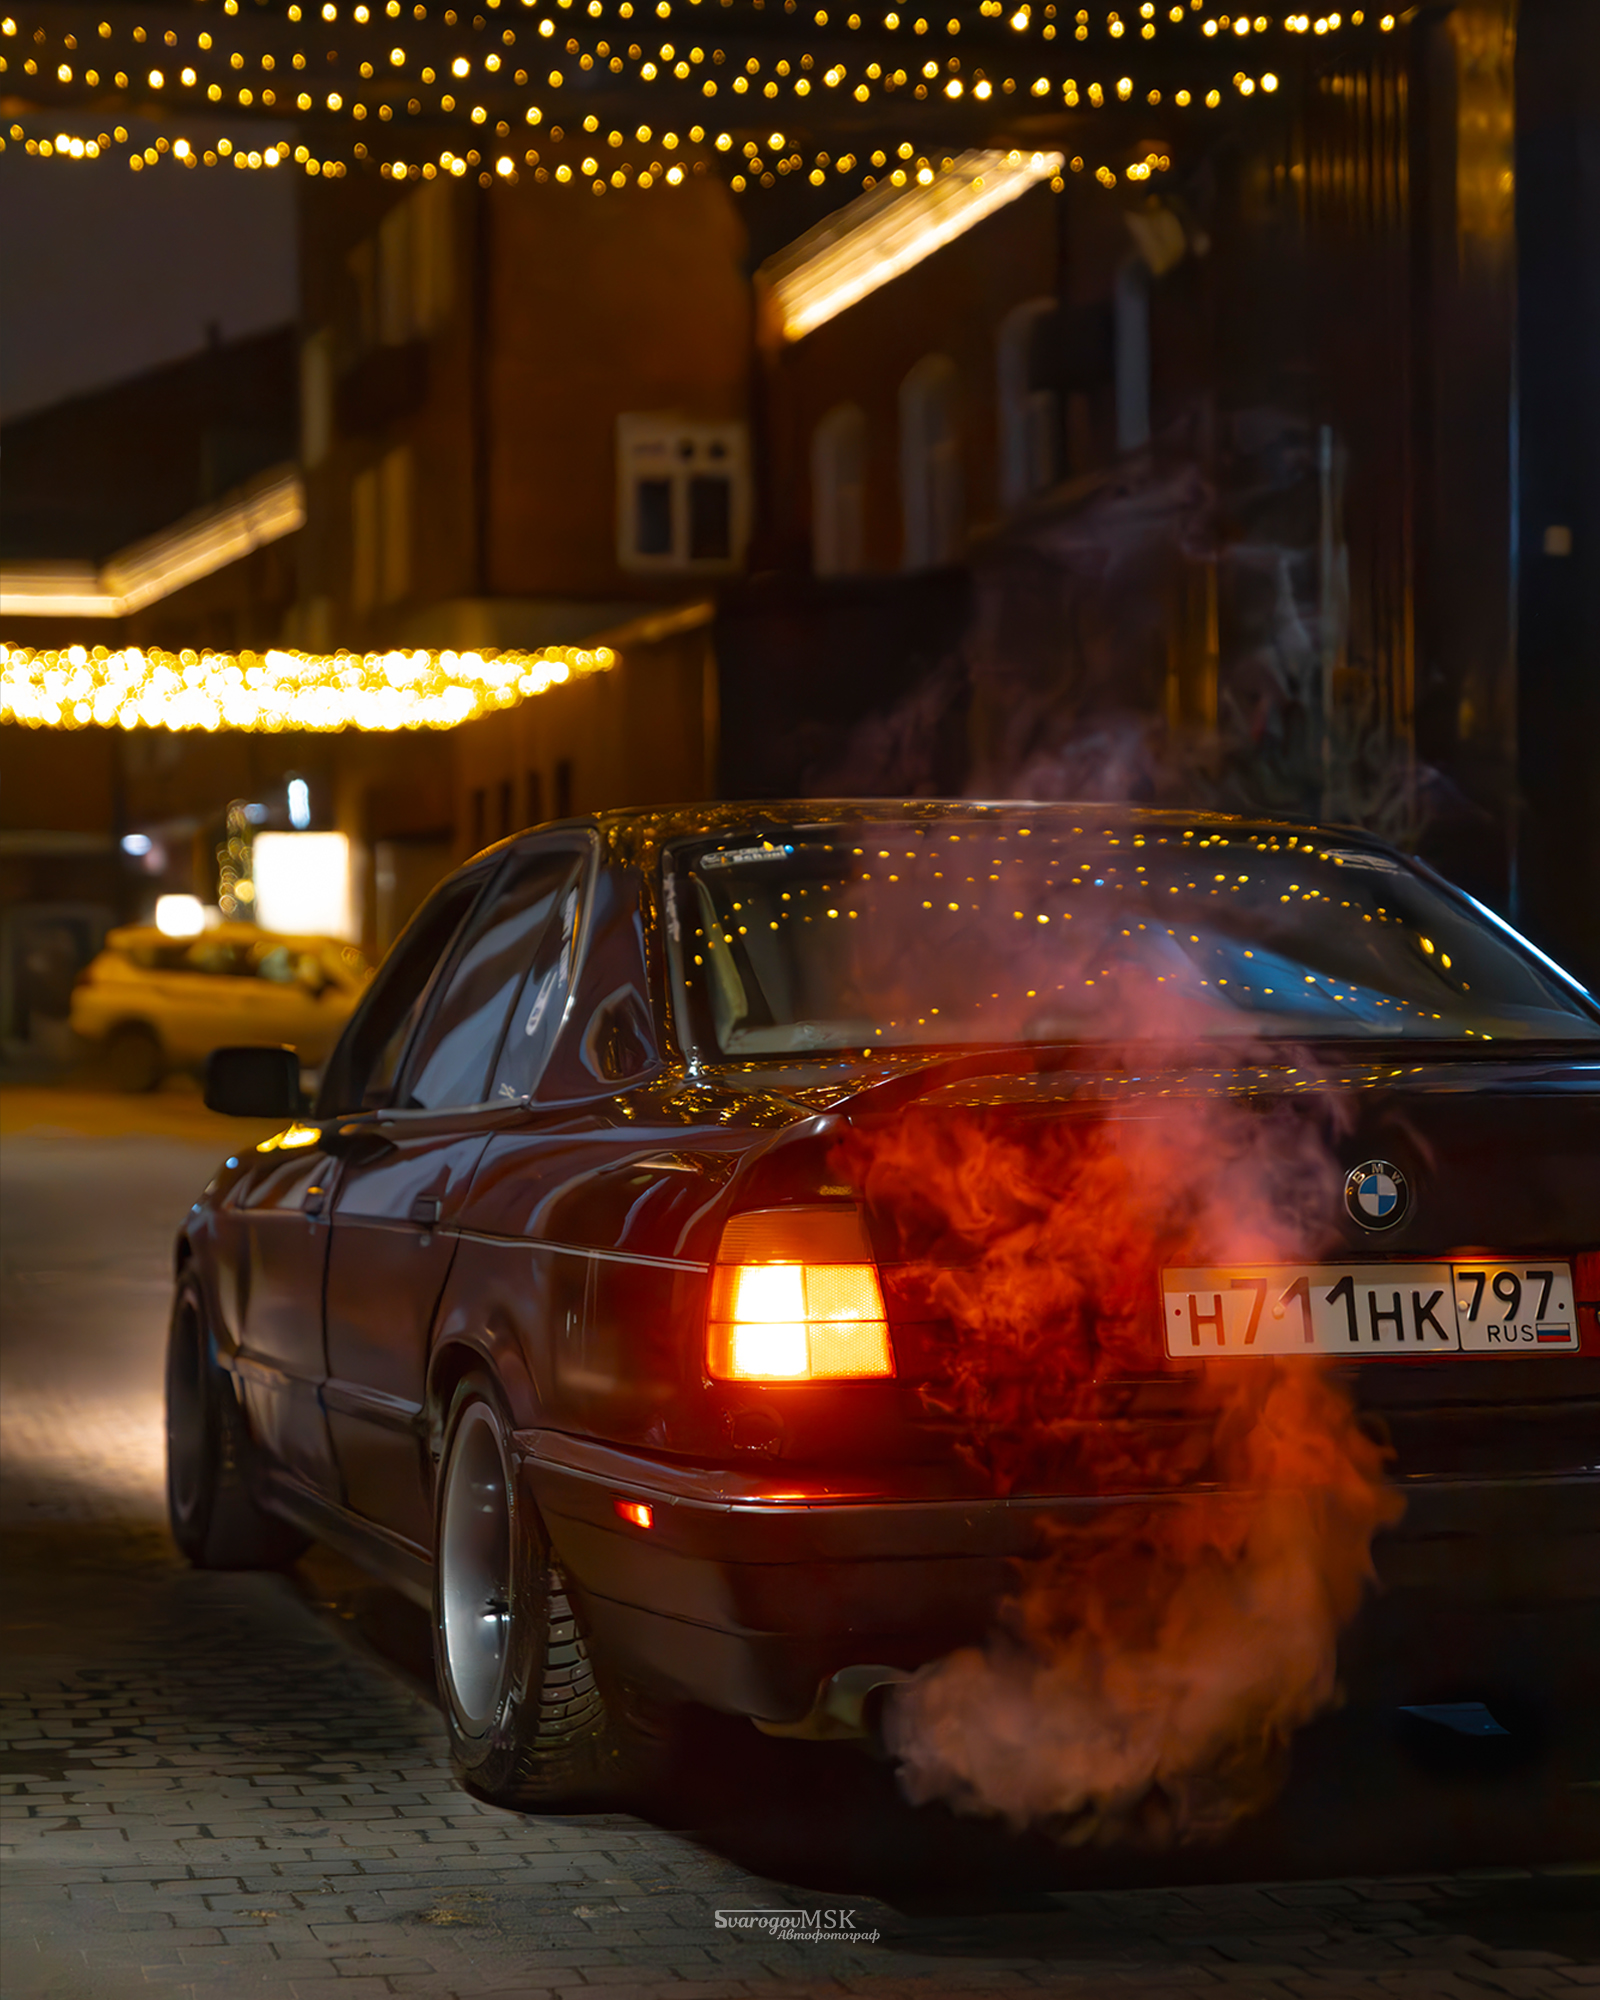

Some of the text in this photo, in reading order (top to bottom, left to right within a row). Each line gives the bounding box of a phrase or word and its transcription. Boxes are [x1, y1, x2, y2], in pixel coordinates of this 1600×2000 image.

[1353, 1162, 1403, 1186] BMW
[1458, 1270, 1553, 1321] 797
[1487, 1324, 1534, 1343] RUS
